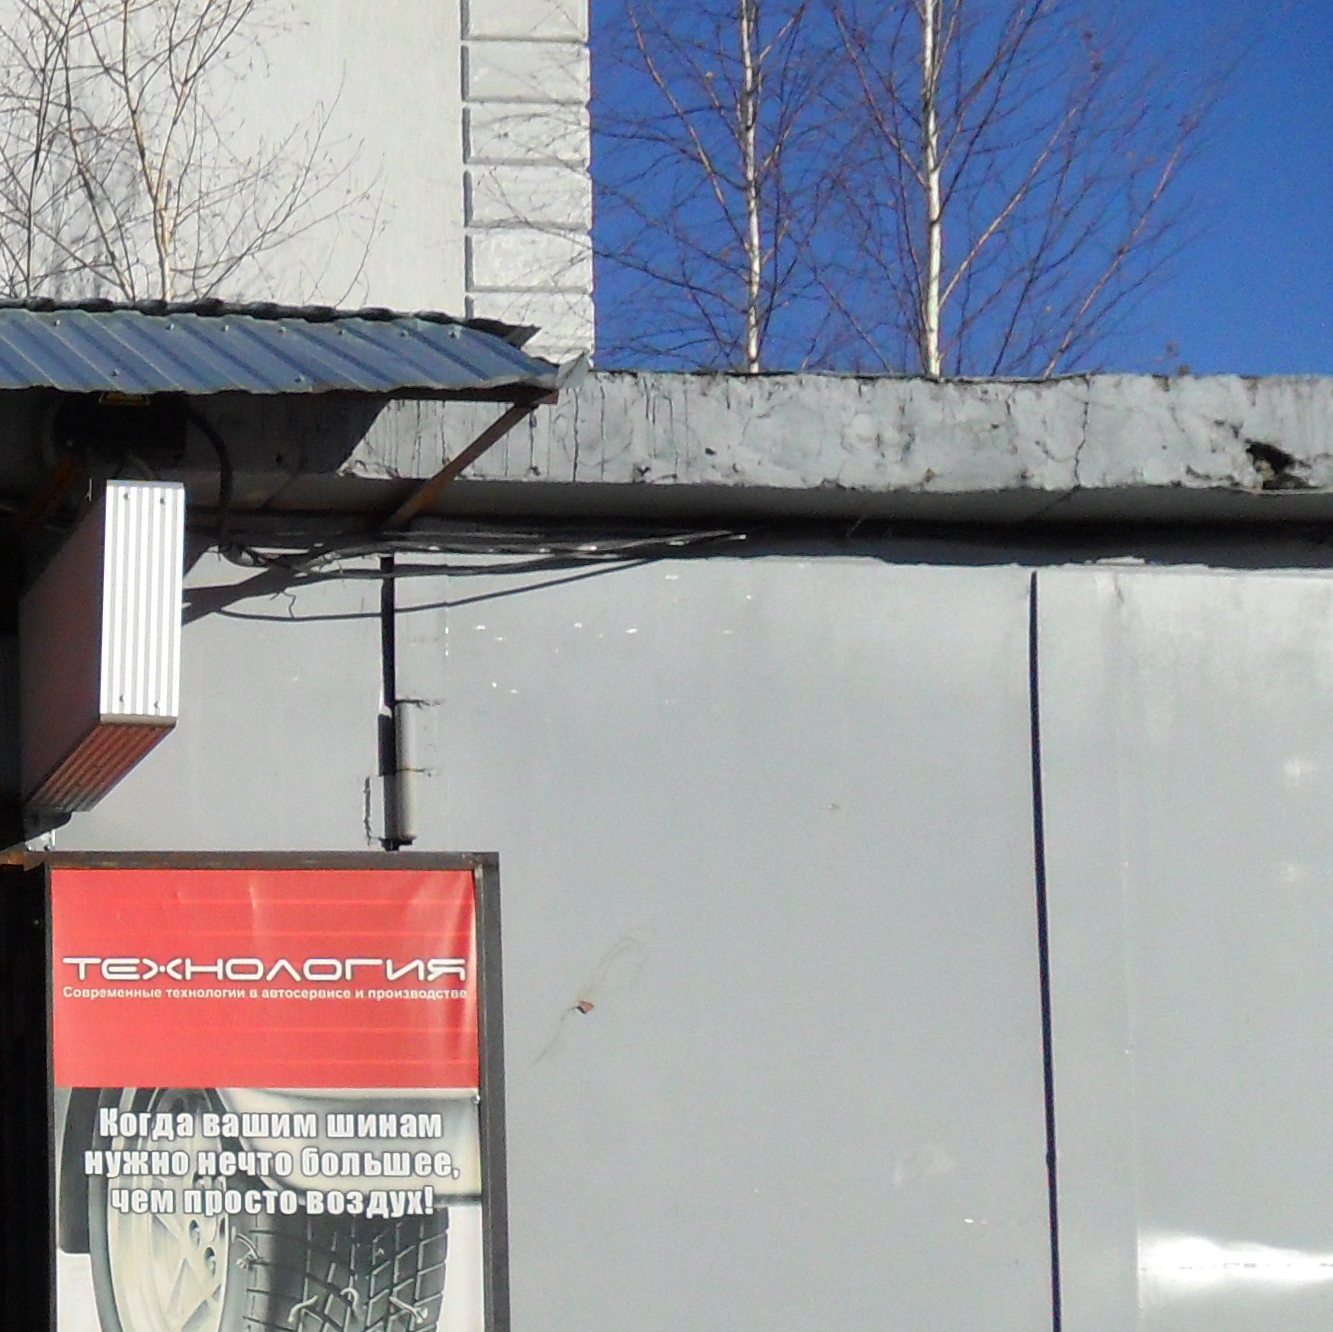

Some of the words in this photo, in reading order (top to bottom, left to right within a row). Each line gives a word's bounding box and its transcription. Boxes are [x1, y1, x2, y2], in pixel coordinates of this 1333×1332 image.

[62, 957, 467, 981] ТЕХНОЛОГИЯ
[63, 986, 162, 1001] Современные
[164, 987, 246, 1000] технологии
[249, 987, 259, 999] в
[260, 987, 351, 1001] автосервисе
[355, 988, 365, 999] и
[367, 987, 467, 1002] производстве
[99, 1107, 193, 1141] Когда
[203, 1111, 317, 1139] вашим
[326, 1112, 442, 1139] шинам
[84, 1149, 188, 1182] нужно
[197, 1150, 293, 1177] нечто
[301, 1148, 461, 1182] большее,
[110, 1188, 175, 1214] чем
[183, 1188, 297, 1218] просто
[306, 1186, 434, 1218] воздух!
